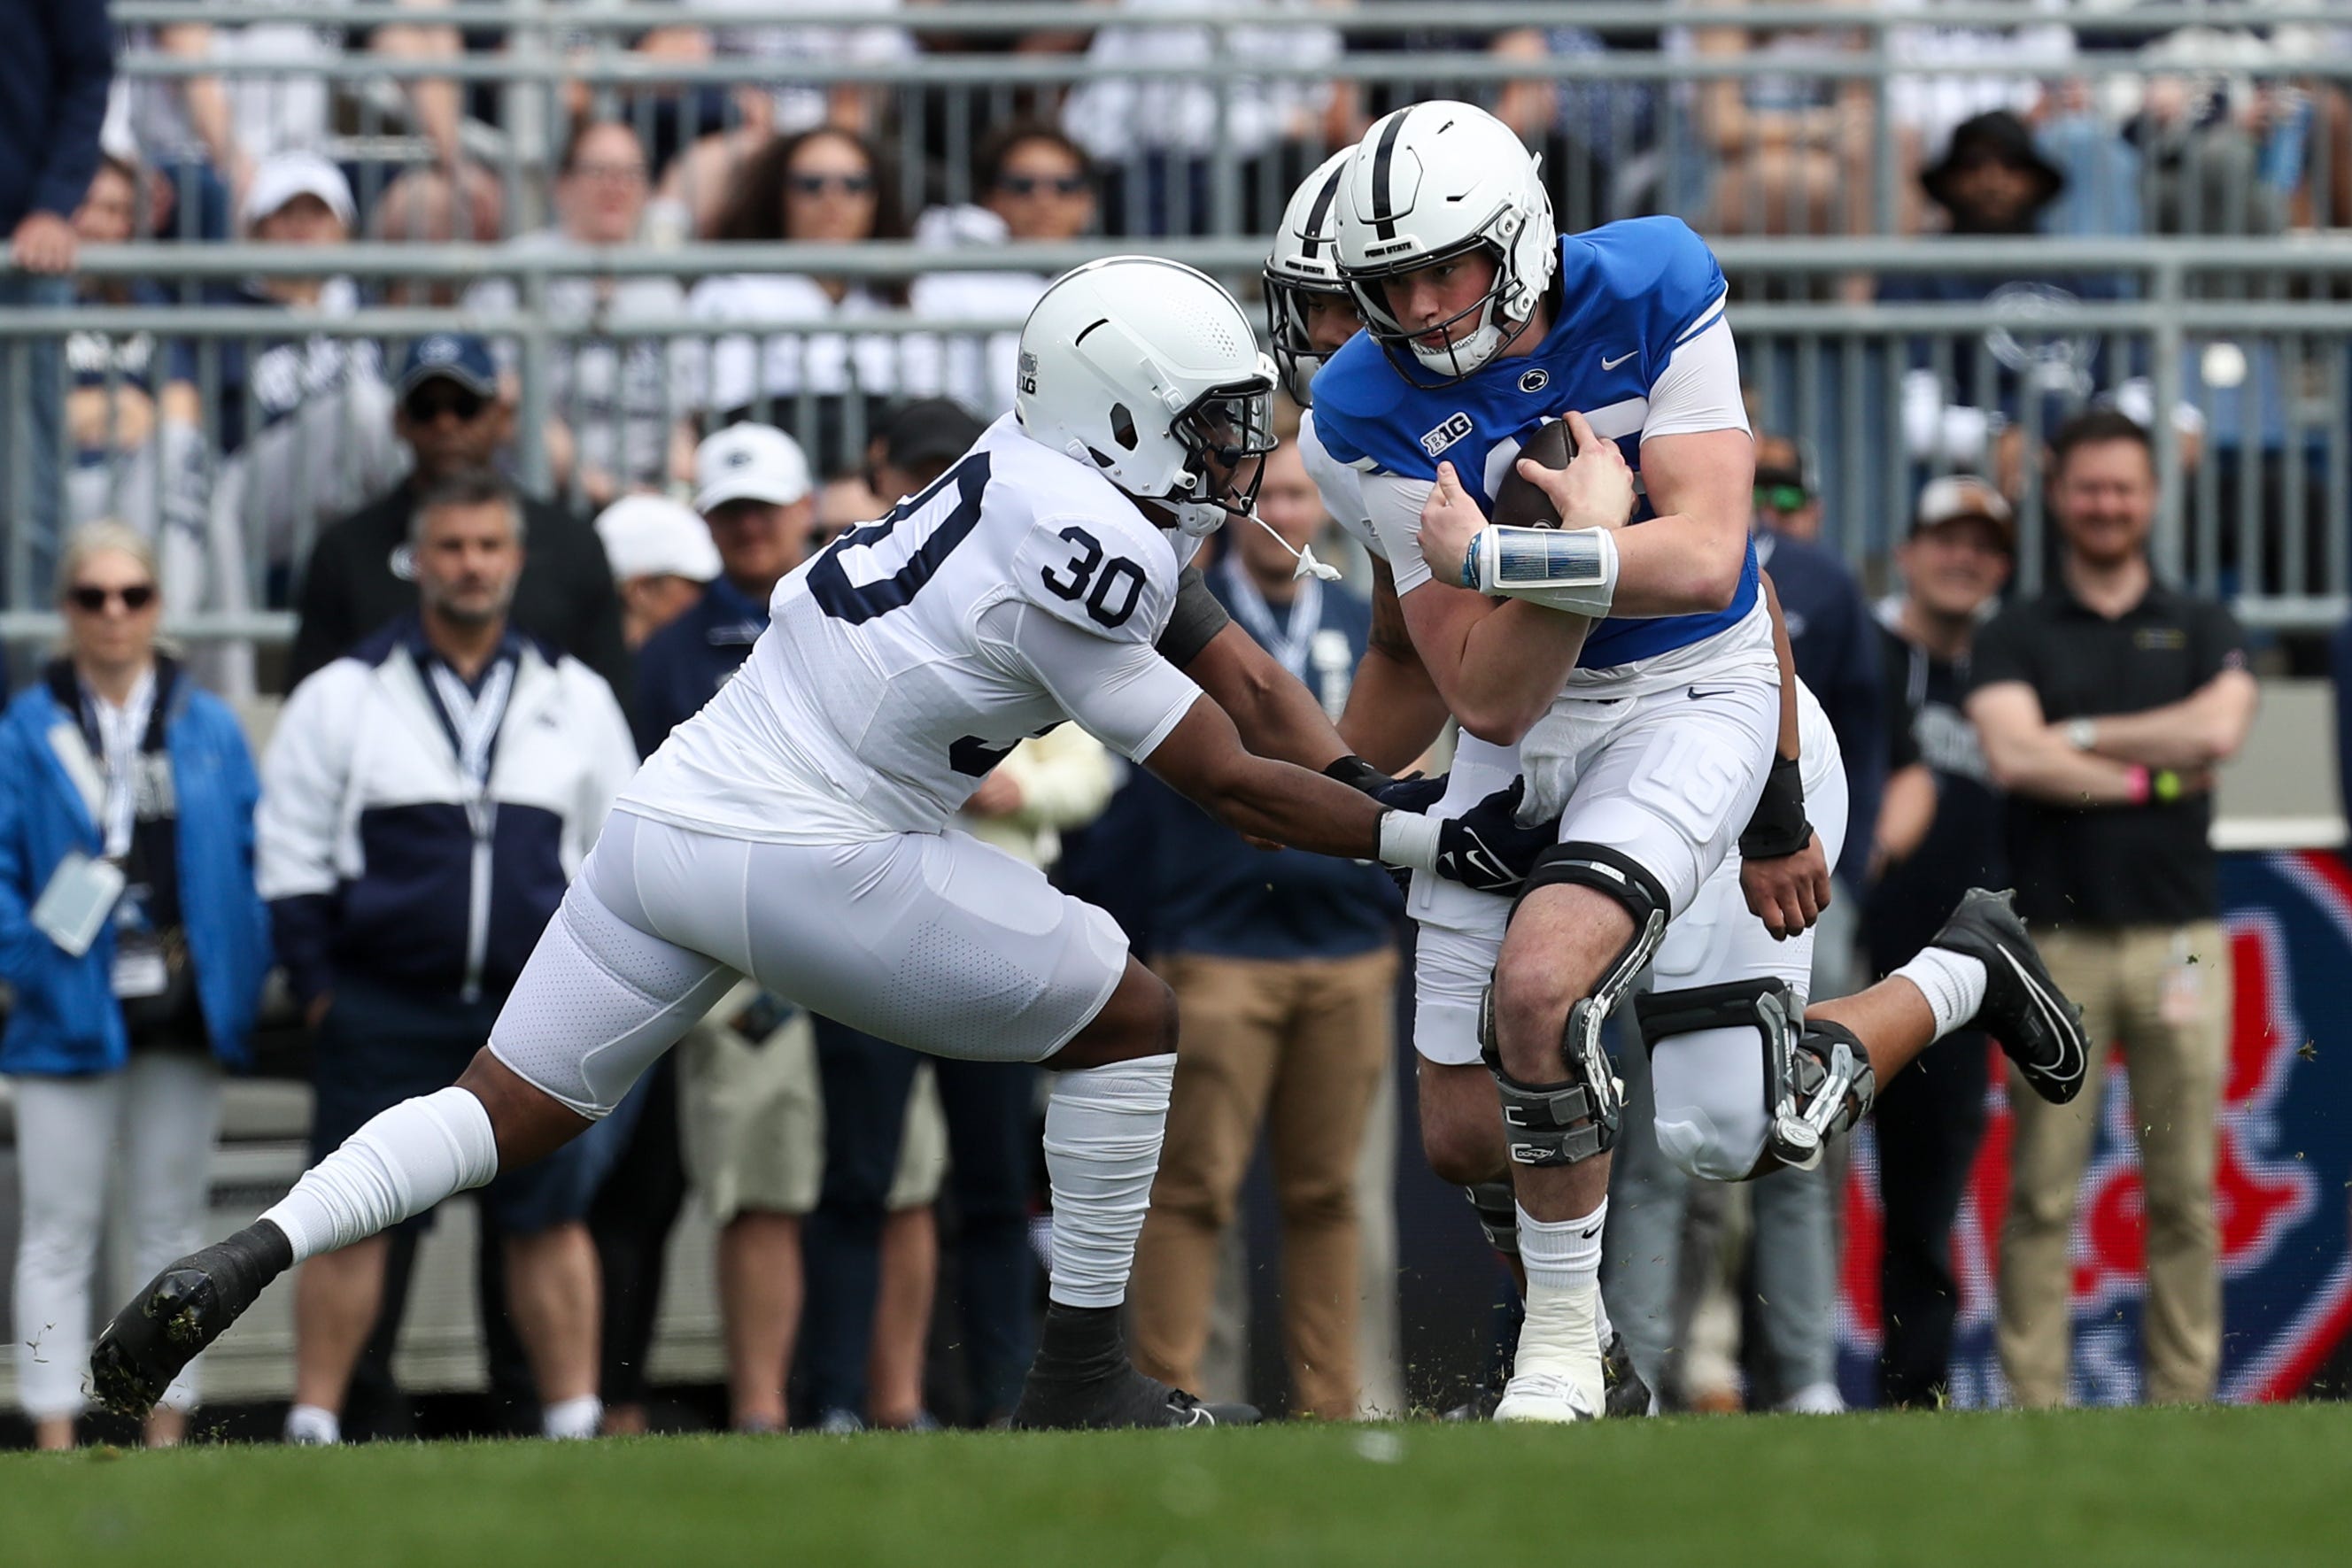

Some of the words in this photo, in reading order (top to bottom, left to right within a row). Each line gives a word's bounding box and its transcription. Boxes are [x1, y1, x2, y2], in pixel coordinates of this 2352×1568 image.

[1386, 242, 1412, 255] STATE
[1040, 525, 1147, 630] 30
[1644, 727, 1738, 818] 15
